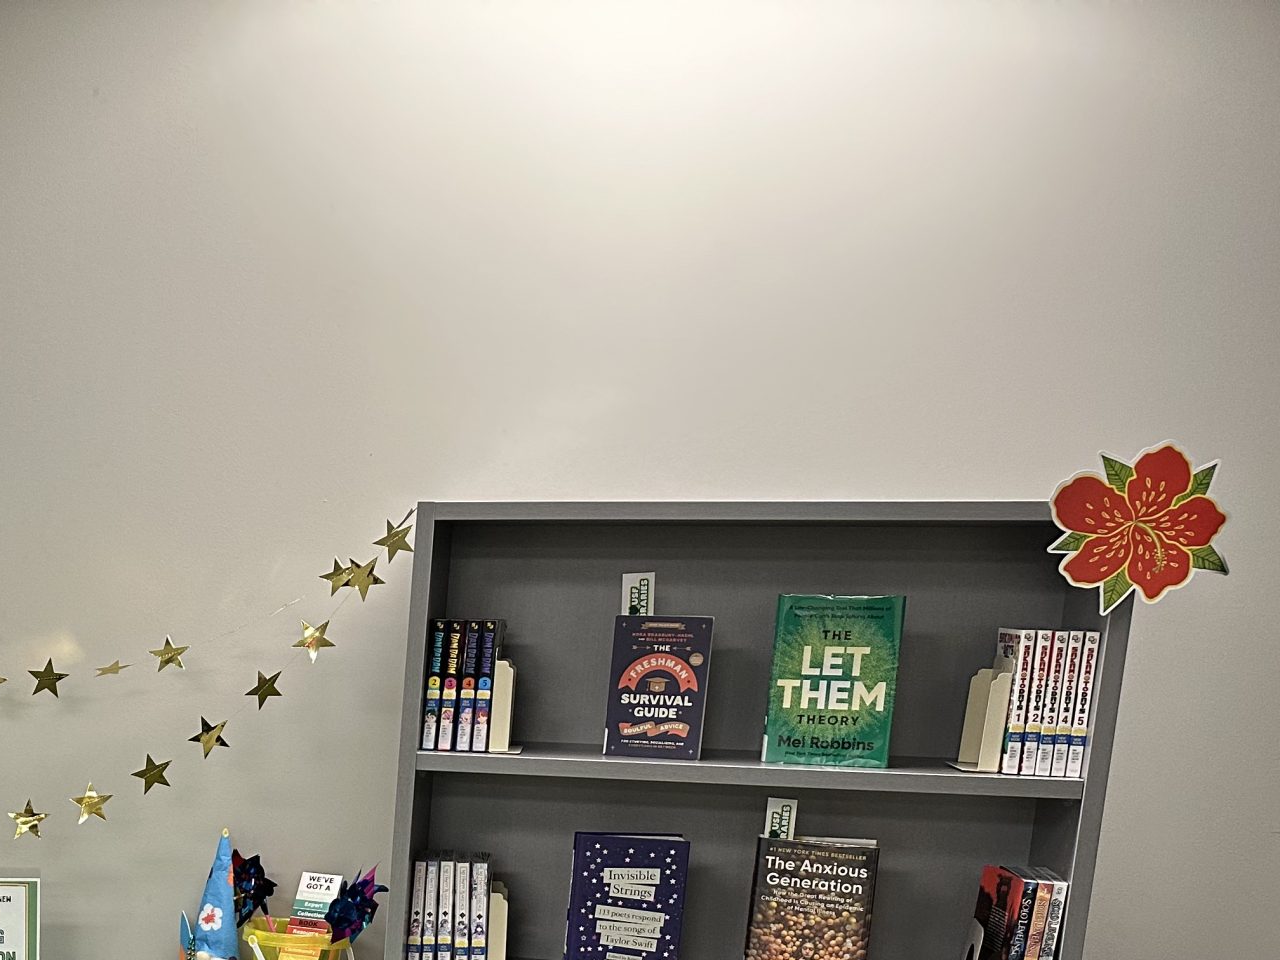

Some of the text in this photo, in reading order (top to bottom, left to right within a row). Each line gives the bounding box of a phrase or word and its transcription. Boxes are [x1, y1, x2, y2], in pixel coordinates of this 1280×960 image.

[631, 587, 639, 605] USF
[822, 630, 852, 640] THE
[653, 644, 671, 652] THE
[801, 646, 871, 676] LET
[630, 658, 688, 679] FRESHMAN
[621, 693, 692, 706] SURVIVAL
[777, 679, 887, 711] THEM
[634, 707, 677, 718] GUIDE
[1016, 713, 1020, 721] 1
[1032, 714, 1039, 722] 2
[797, 714, 860, 725] THEORY
[1047, 716, 1054, 724] 3
[1062, 715, 1068, 724] 4
[1077, 717, 1084, 725] 5
[623, 724, 652, 734] SOULFUL
[778, 735, 874, 751] Mel Robbins
[766, 856, 868, 878] The Anxious
[309, 876, 334, 884] WE'VE
[608, 870, 657, 881] Invisible
[766, 873, 862, 894] Generation
[612, 884, 652, 899] Strings
[1027, 886, 1033, 894] 2
[1021, 898, 1032, 921] SOLO
[611, 911, 630, 919] poets
[632, 913, 662, 923] respond
[608, 924, 622, 932] the
[623, 926, 645, 934] songs
[605, 935, 653, 949] Taylor Swift
